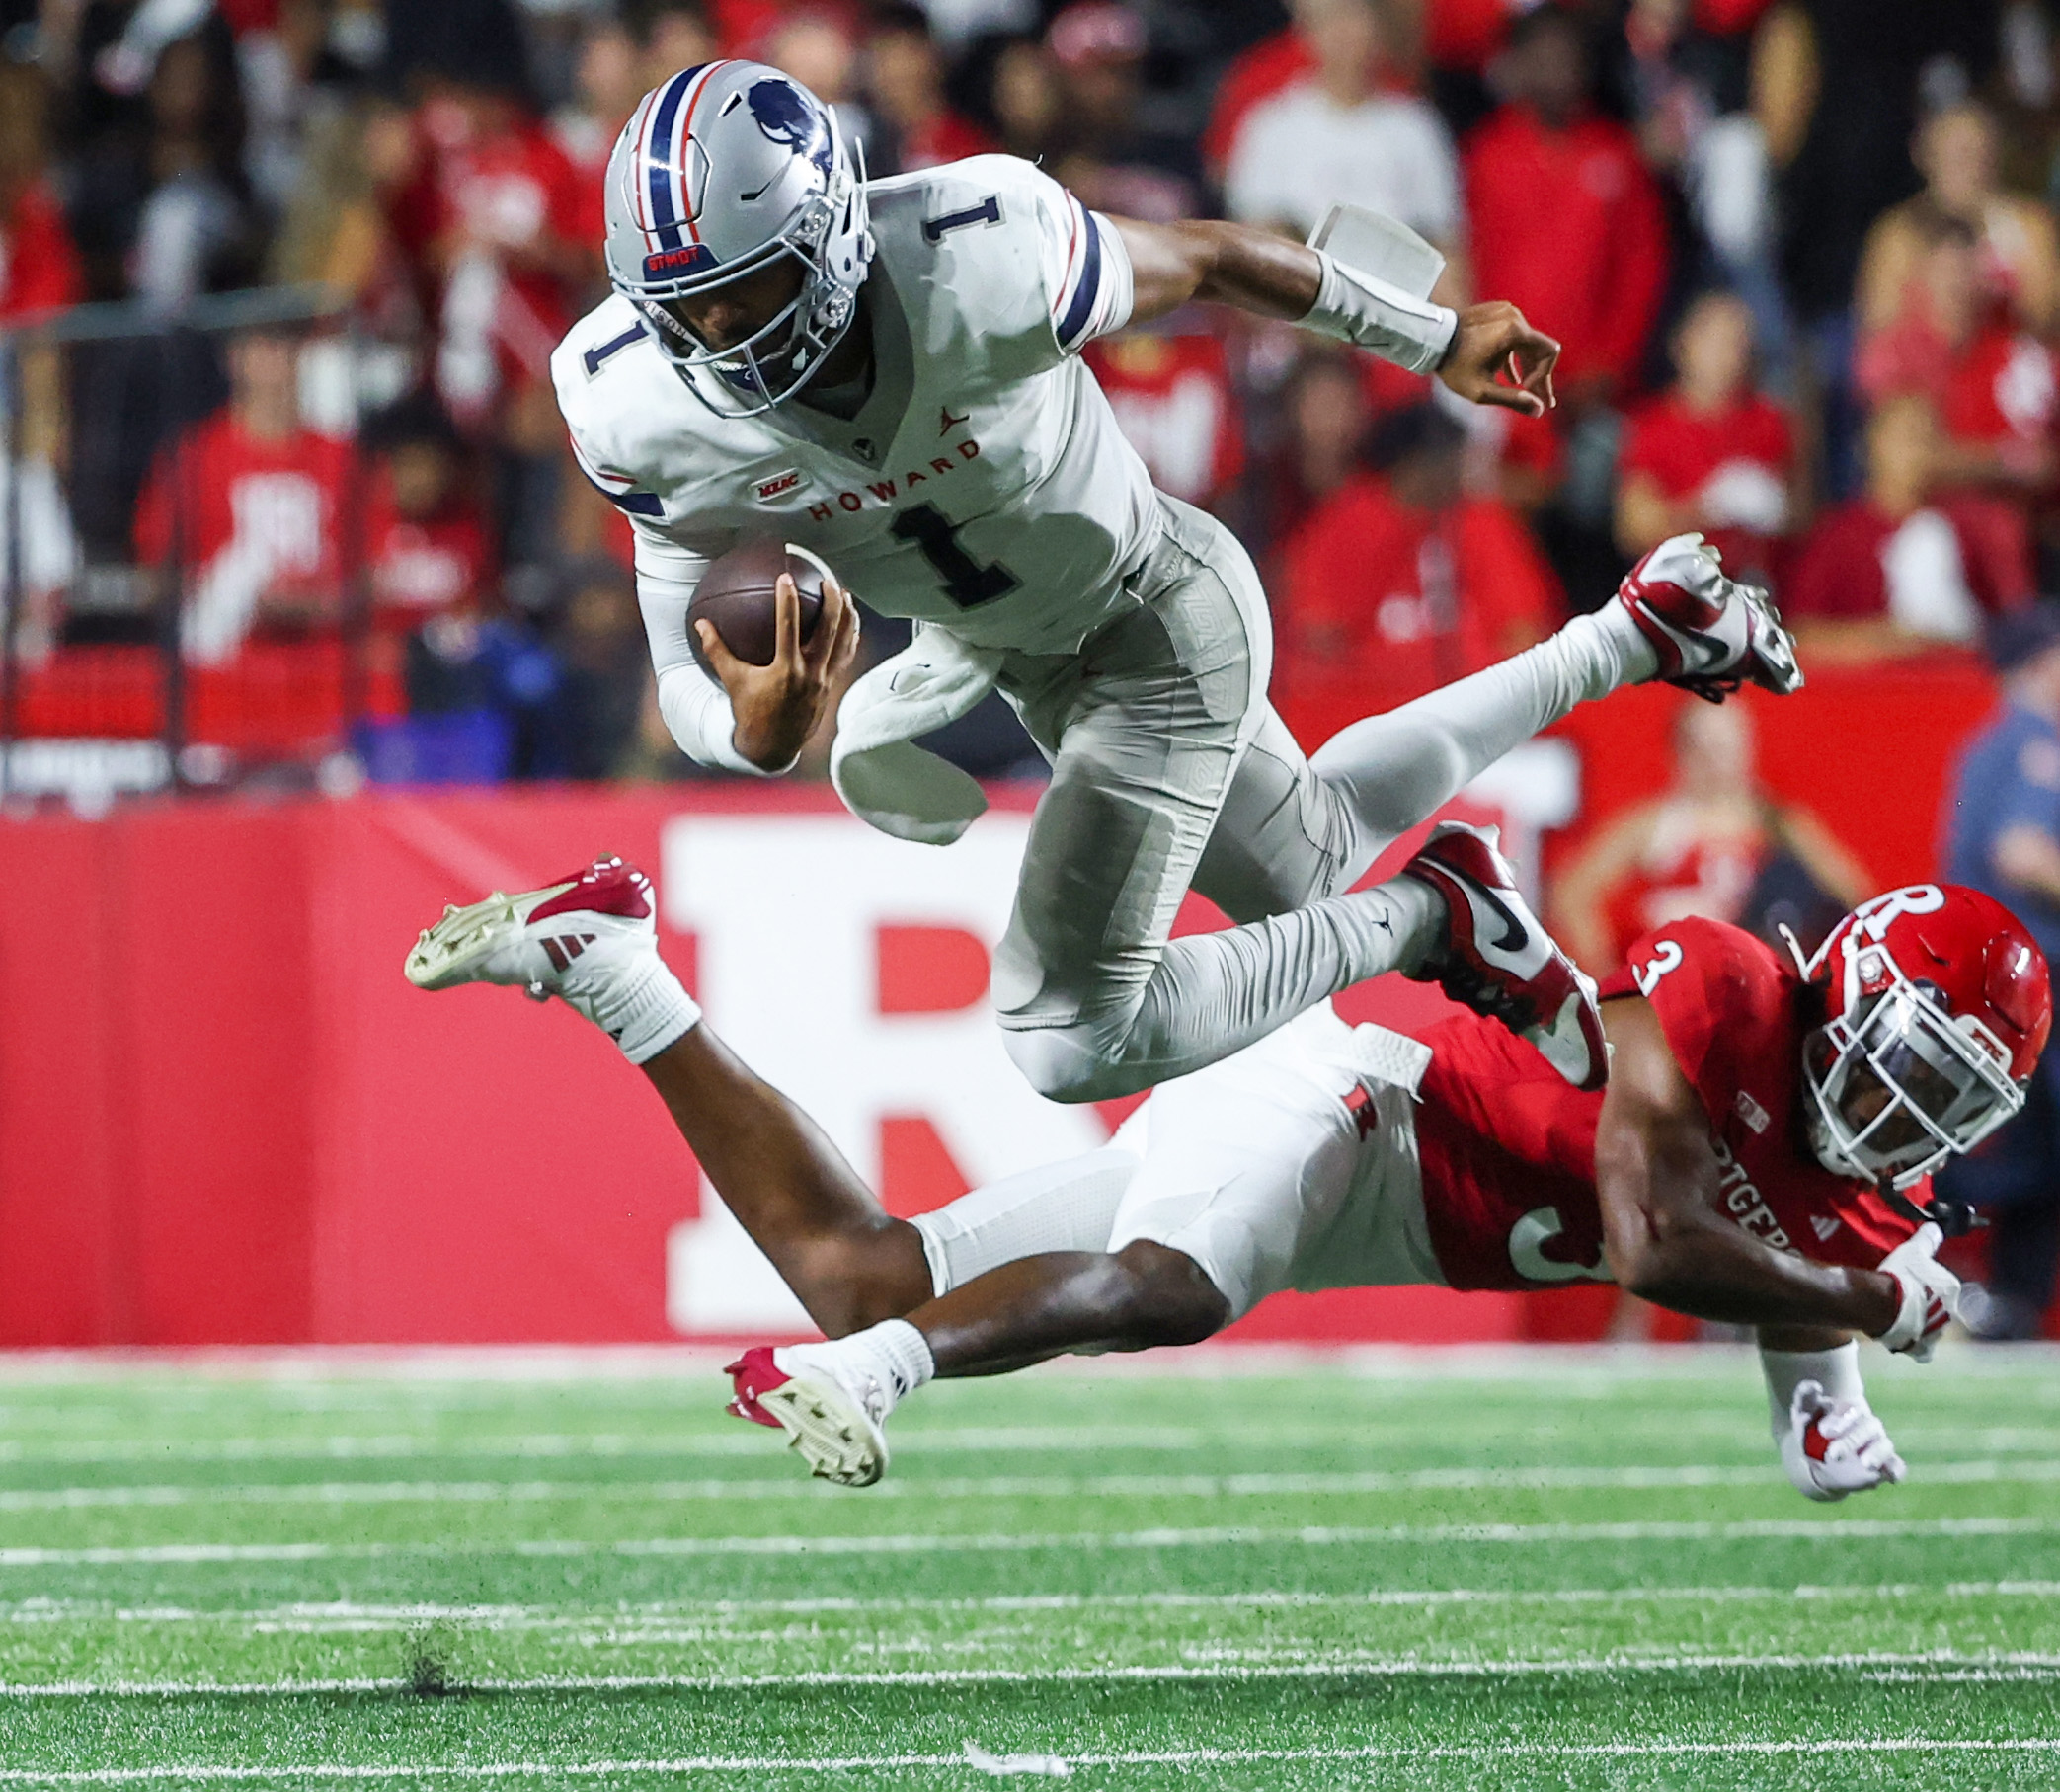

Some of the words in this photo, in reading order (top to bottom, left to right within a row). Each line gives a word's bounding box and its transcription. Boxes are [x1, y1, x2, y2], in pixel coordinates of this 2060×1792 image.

[922, 194, 1005, 246] 1
[580, 318, 651, 382] 1
[808, 439, 981, 522] HOWARD
[888, 500, 1025, 611] 1
[1853, 883, 1945, 942] R
[1631, 938, 1684, 998] 3
[664, 815, 1111, 1333] R
